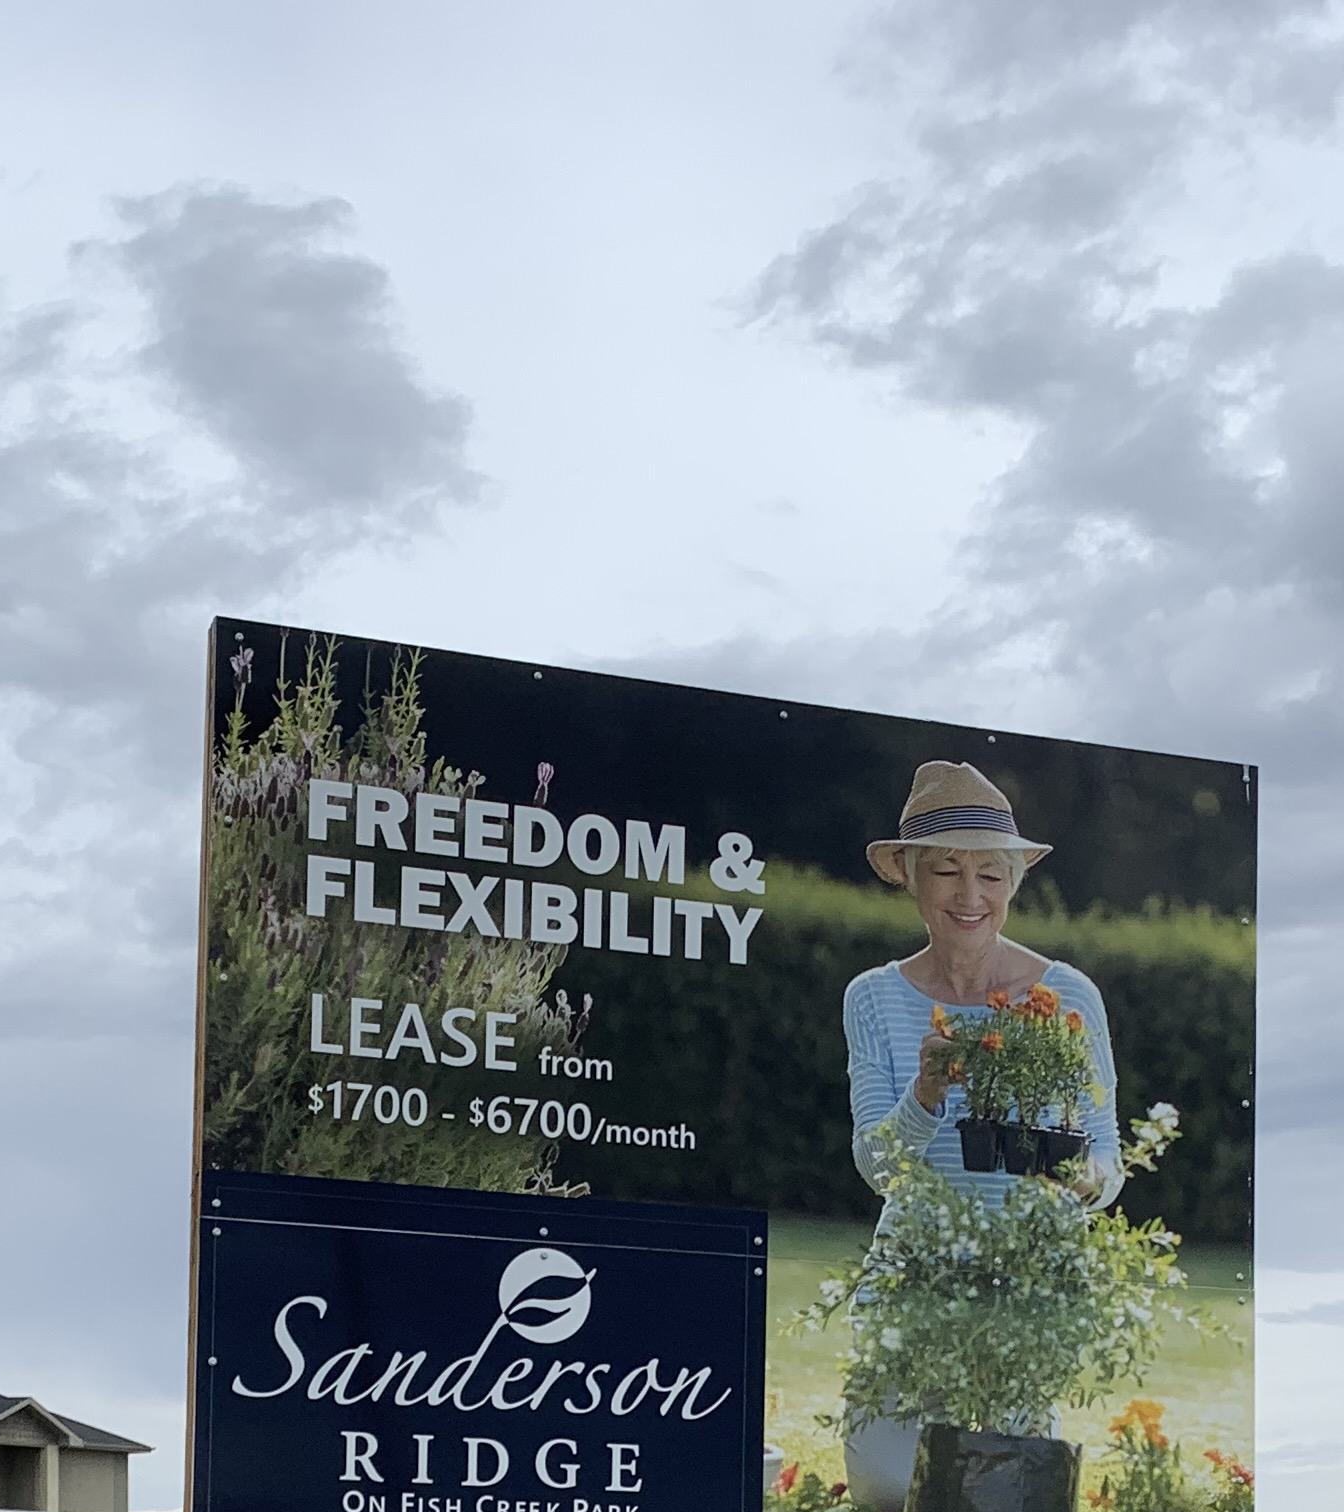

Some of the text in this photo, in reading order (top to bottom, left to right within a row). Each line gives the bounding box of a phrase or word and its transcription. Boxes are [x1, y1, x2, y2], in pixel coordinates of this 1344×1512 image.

[308, 777, 766, 895] FREEDOM &
[306, 854, 764, 965] FLEXIBILITY
[310, 993, 613, 1081] LEASE from
[307, 1082, 428, 1127] $1700
[468, 1097, 696, 1150] $6700/month
[232, 1295, 732, 1421] Sanderson
[339, 1430, 643, 1493] RIDGE
